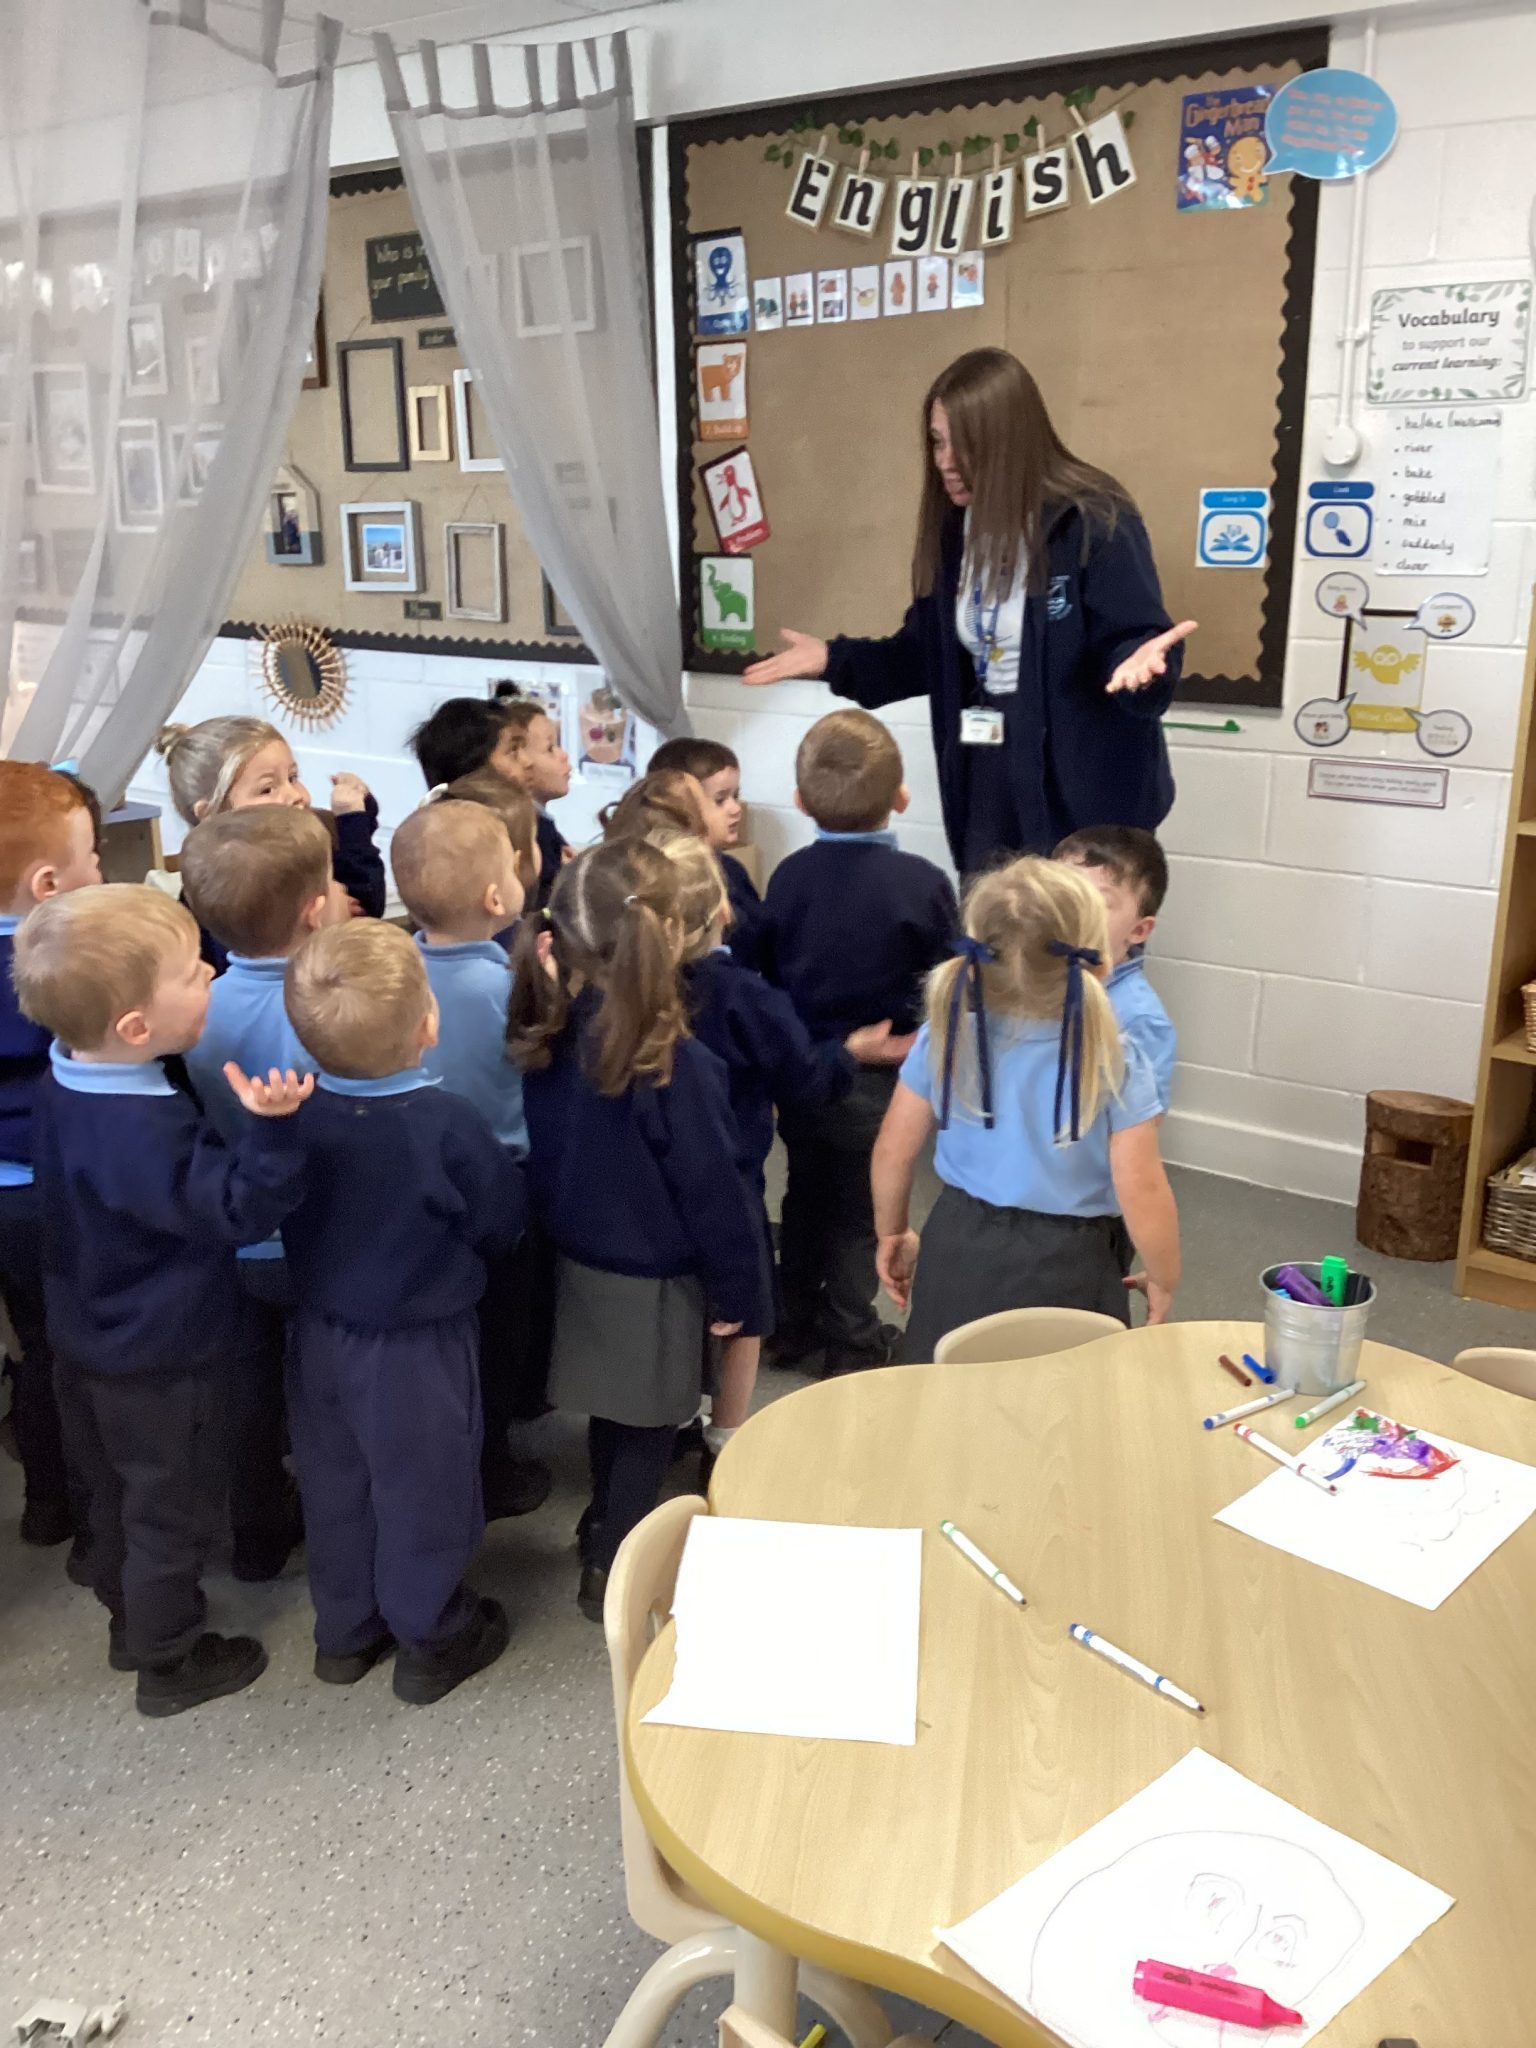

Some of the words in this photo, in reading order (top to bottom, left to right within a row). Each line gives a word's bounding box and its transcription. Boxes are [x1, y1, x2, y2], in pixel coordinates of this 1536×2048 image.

[791, 133, 1131, 252] English
[1398, 307, 1501, 328] Vocabulary
[1402, 340, 1416, 351] to
[1418, 337, 1465, 352] support
[1468, 337, 1493, 347] our
[1391, 358, 1440, 372] current
[1404, 466, 1433, 479] bake
